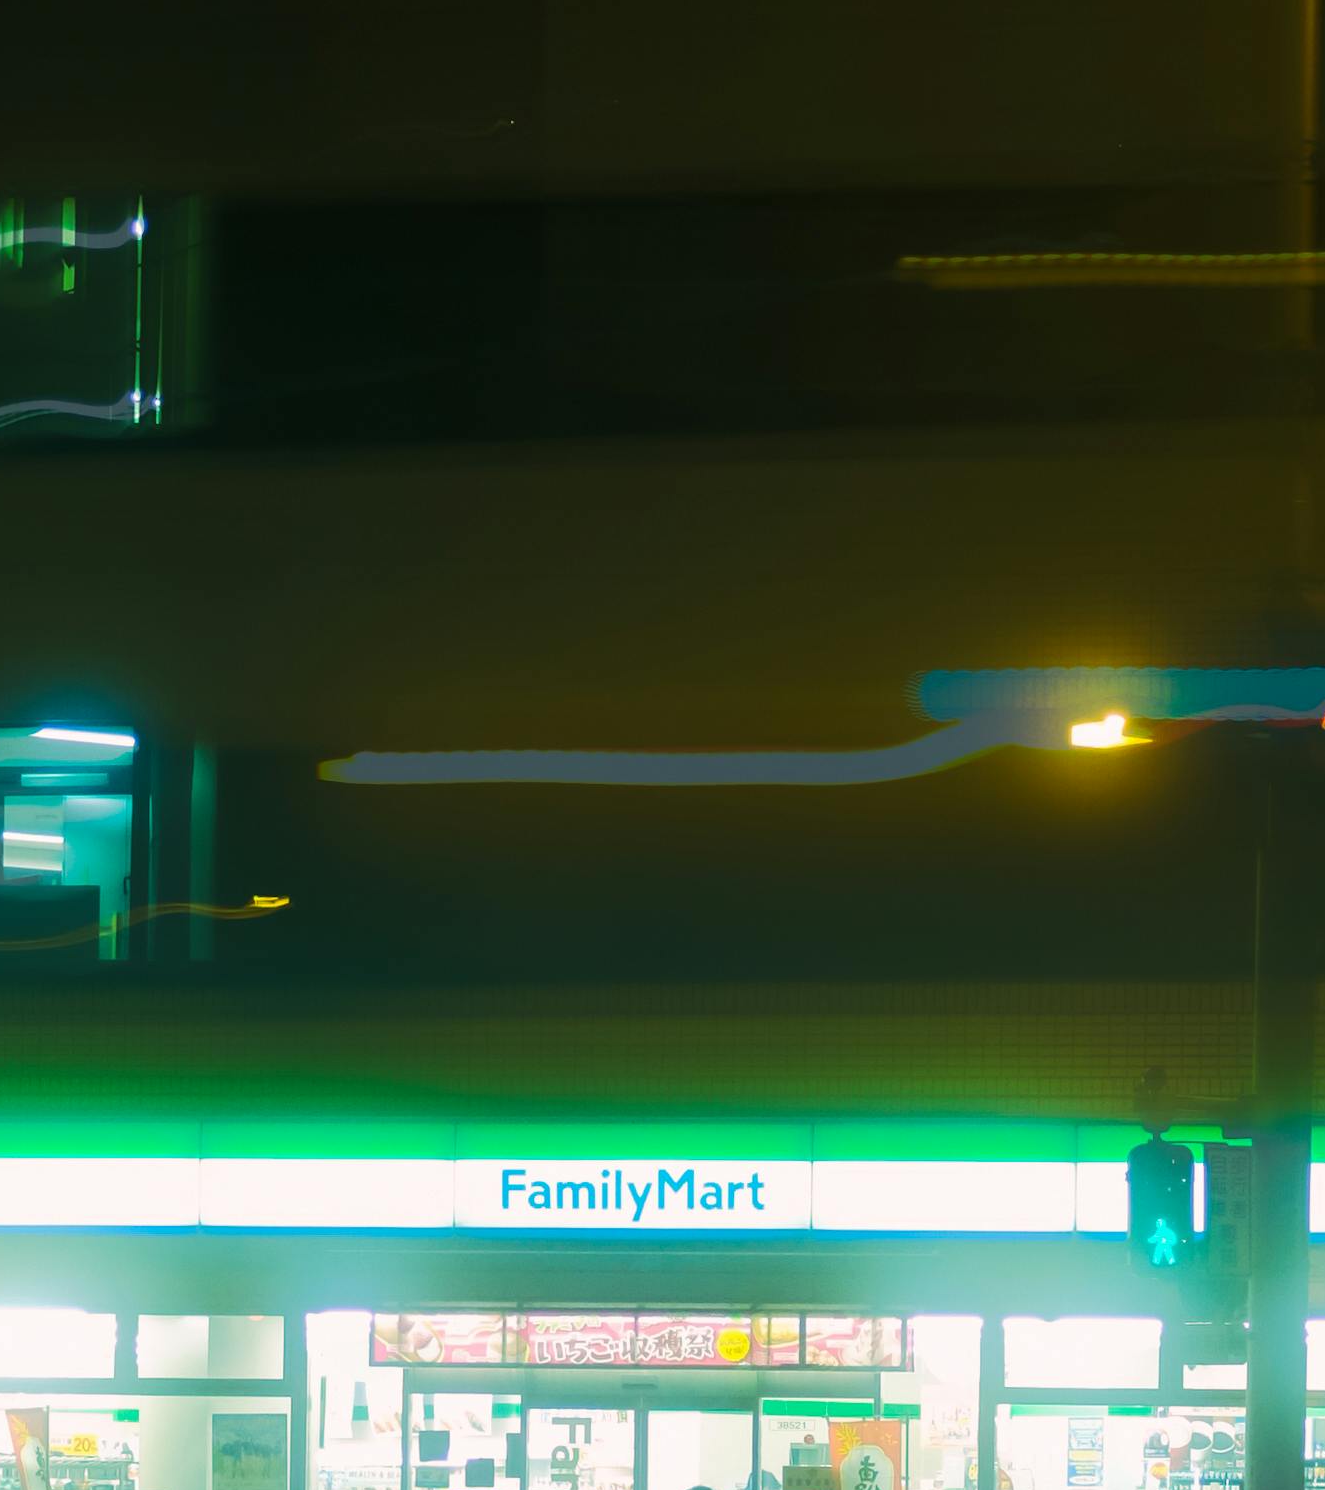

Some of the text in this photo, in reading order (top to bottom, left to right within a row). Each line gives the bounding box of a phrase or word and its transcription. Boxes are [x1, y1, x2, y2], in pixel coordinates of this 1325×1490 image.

[502, 1169, 765, 1222] FamilyMart
[536, 1328, 712, 1363] いちご収穫祭
[776, 1421, 807, 1430] 38521
